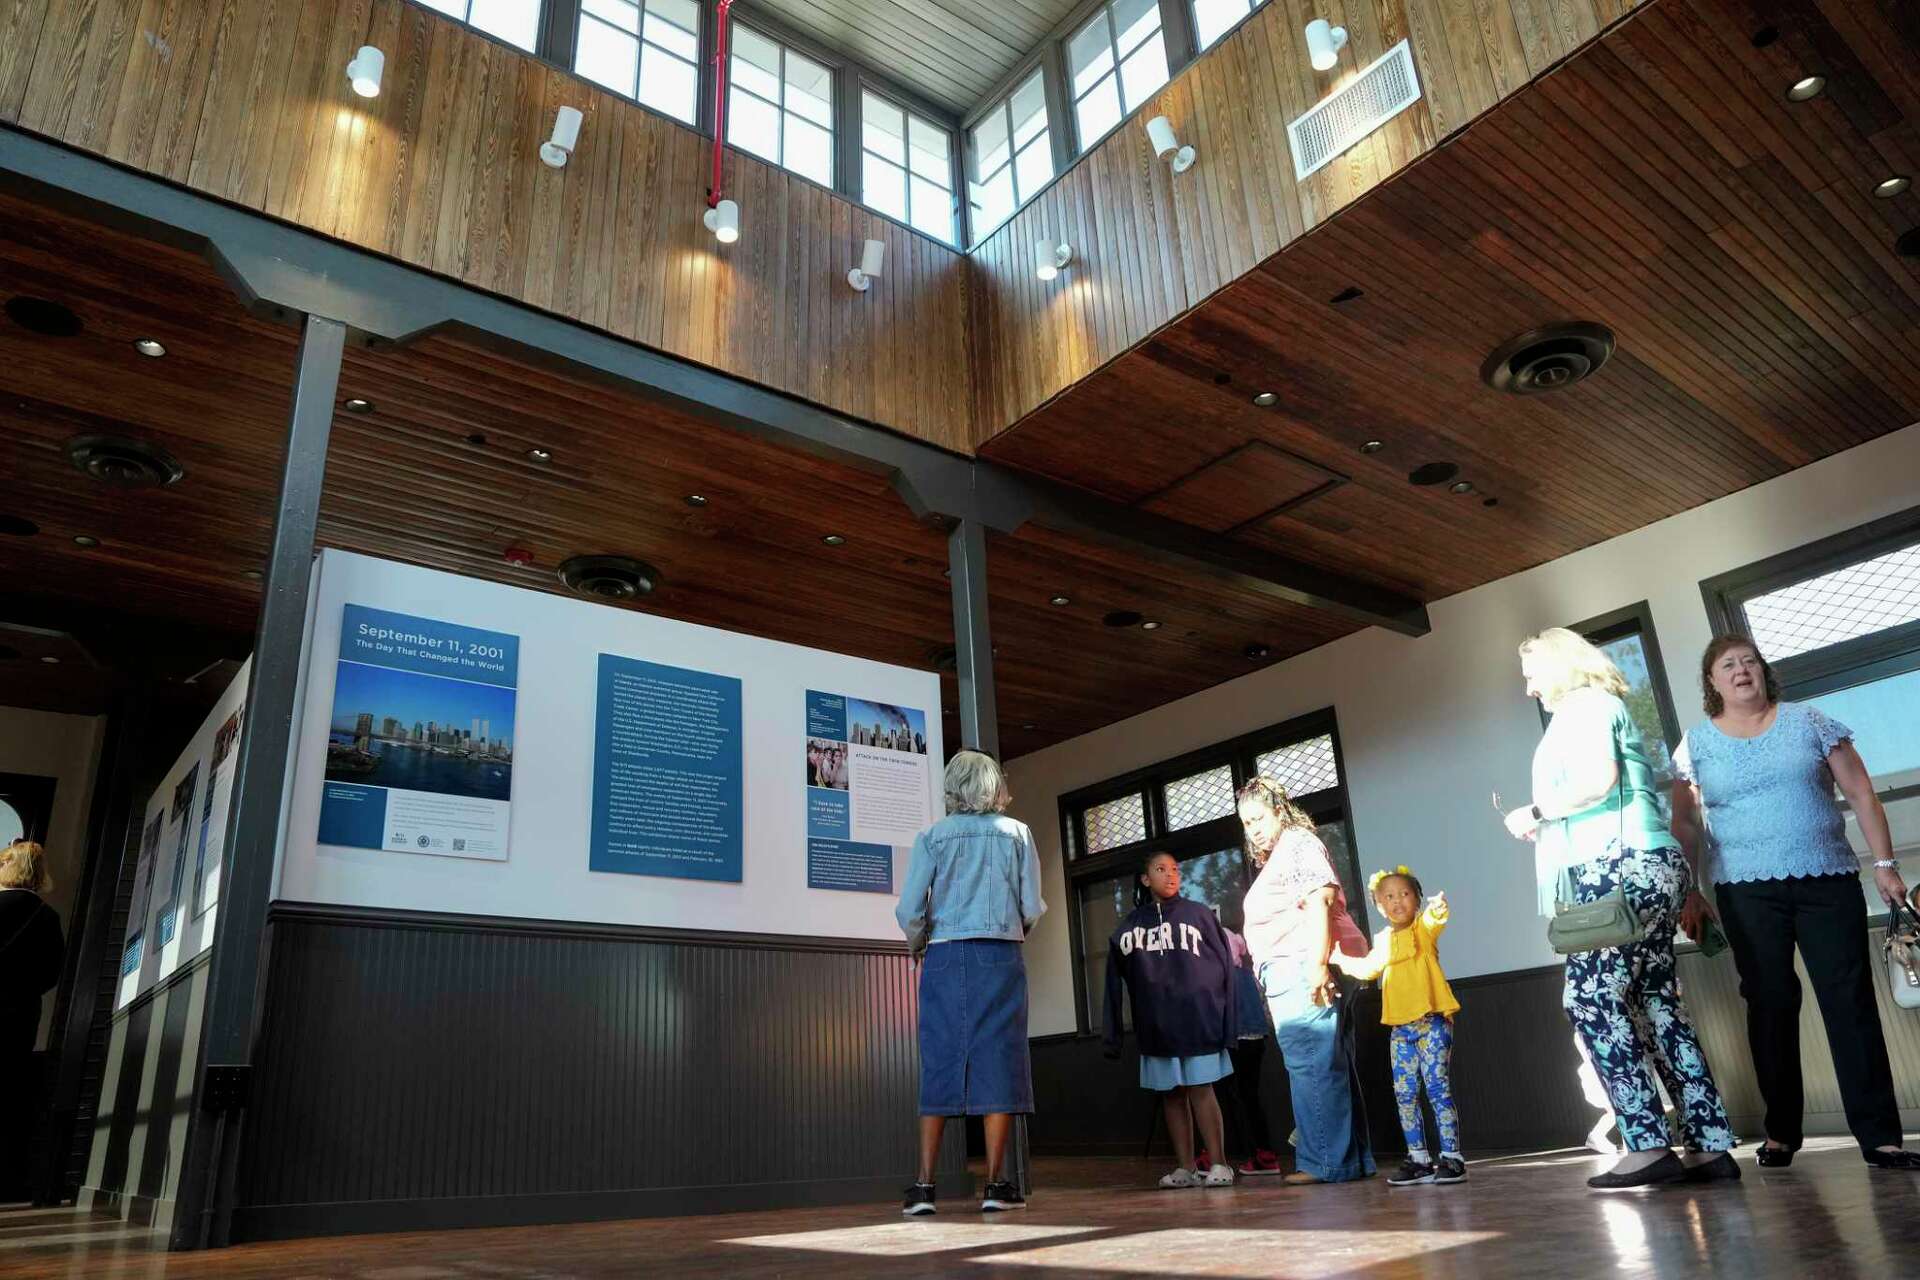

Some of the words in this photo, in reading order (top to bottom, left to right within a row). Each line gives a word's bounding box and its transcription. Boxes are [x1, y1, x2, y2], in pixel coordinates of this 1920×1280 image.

[356, 639, 373, 649] The
[375, 642, 394, 653] Day
[397, 646, 417, 657] That
[419, 650, 459, 664] Changed
[461, 657, 475, 667] the
[478, 660, 505, 672] World
[359, 623, 444, 648] September
[448, 639, 464, 655] 11,
[469, 643, 504, 660] 2001
[1120, 922, 1175, 956] OVER
[1179, 923, 1202, 957] IT
